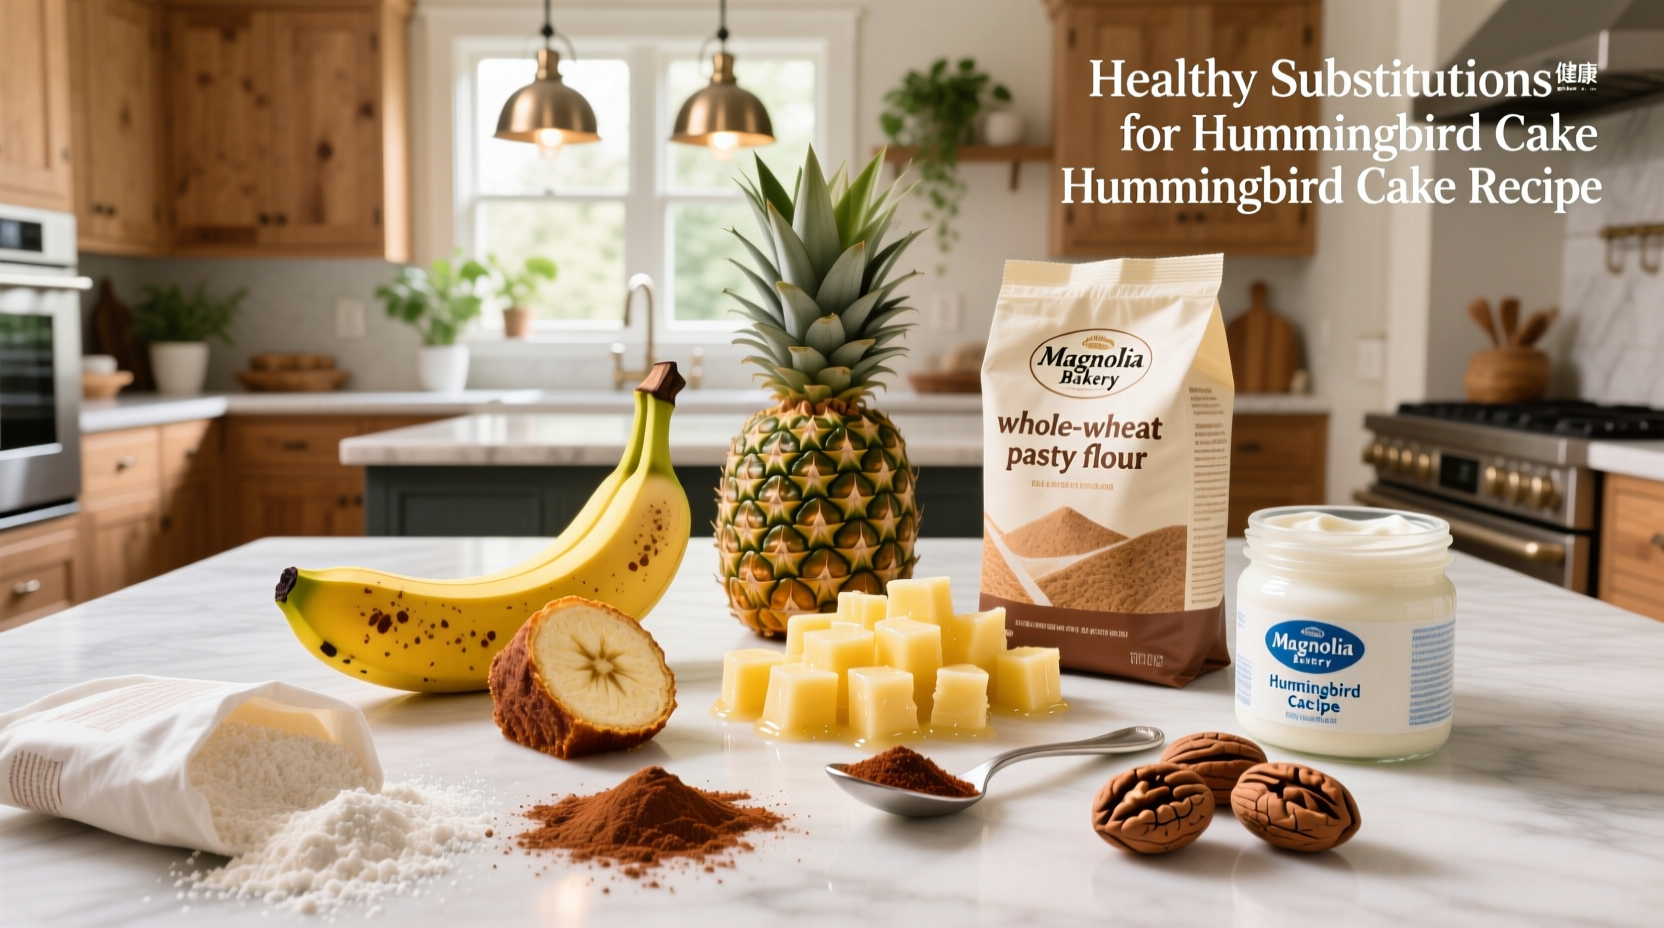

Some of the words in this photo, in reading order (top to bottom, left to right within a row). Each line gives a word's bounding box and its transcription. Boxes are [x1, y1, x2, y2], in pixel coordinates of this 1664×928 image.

[1037, 346, 1144, 373] Magnolia
[1059, 370, 1119, 391] Bakery
[998, 411, 1163, 440] whole-wheat
[1005, 445, 1077, 474] pasty
[1082, 443, 1147, 470] flour
[1272, 632, 1354, 657] Magnolia
